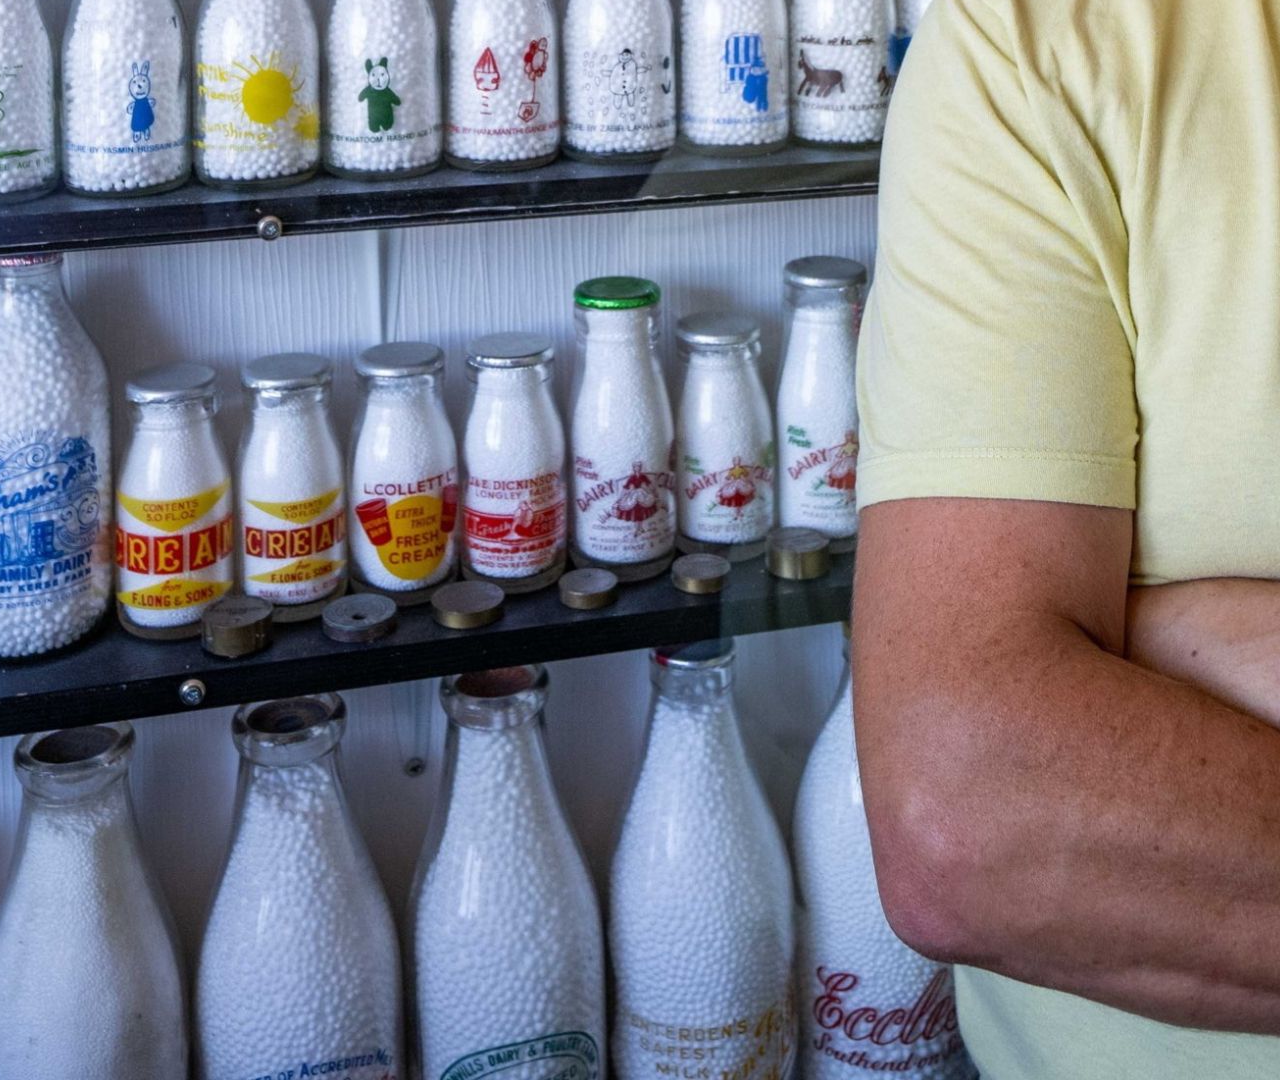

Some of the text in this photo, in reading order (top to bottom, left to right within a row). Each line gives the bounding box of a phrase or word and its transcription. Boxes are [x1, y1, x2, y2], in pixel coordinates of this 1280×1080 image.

[88, 142, 173, 156] BY YASMIN HUSSAIN
[787, 447, 828, 481] DAIRY
[575, 480, 616, 513] DAIRY
[684, 472, 719, 502] DAIRY
[141, 499, 200, 513] CONTENTS
[280, 499, 324, 514] CONTENTS
[395, 531, 440, 551] FRESH
[49, 549, 94, 576] DAIRY
[387, 544, 452, 566] CREAM
[299, 1053, 375, 1080] ACCREDITED
[487, 1047, 522, 1068] DAIRY
[526, 1044, 538, 1058] &
[655, 1062, 711, 1080] MILK
